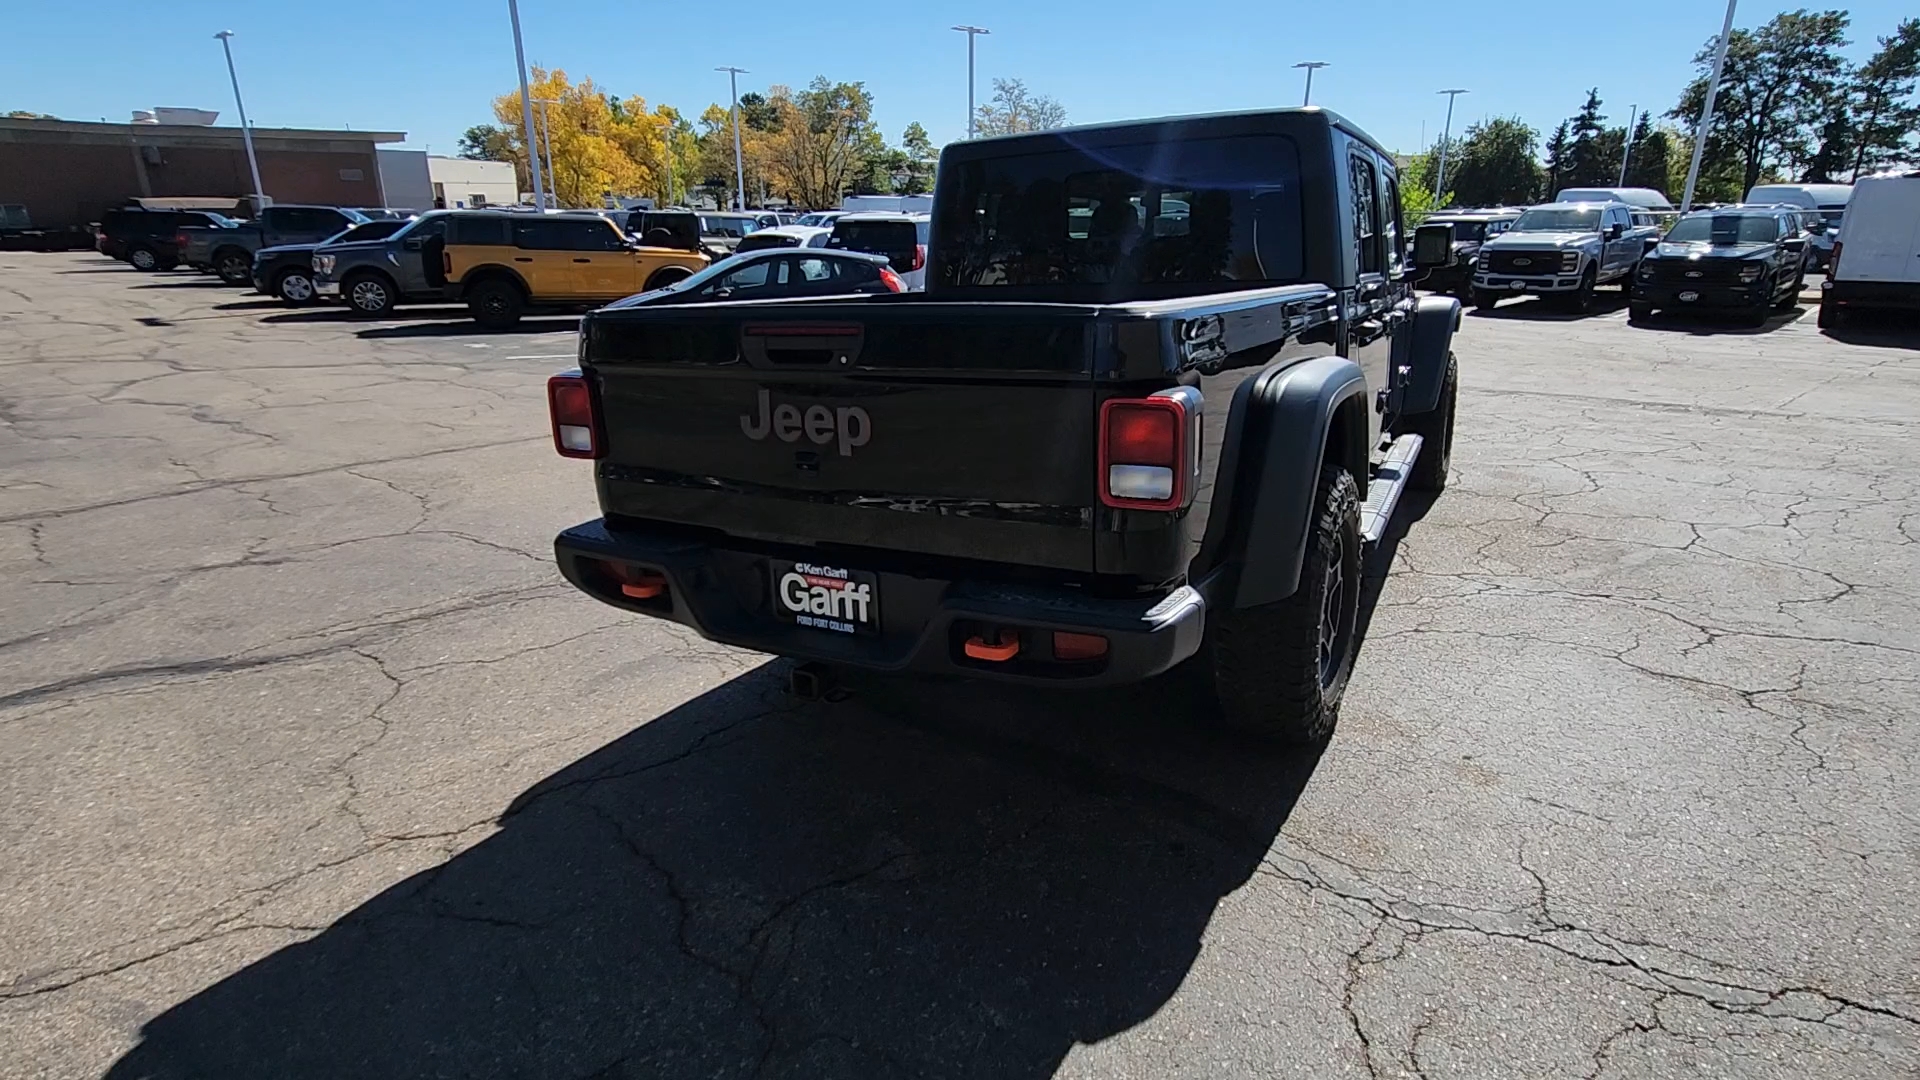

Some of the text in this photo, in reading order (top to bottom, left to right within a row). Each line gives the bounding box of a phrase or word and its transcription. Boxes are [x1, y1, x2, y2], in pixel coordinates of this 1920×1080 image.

[740, 389, 871, 457] Jeep
[803, 563, 848, 579] Ken Garff
[780, 572, 871, 623] Garff
[797, 615, 812, 626] FORD
[813, 618, 828, 629] FORT
